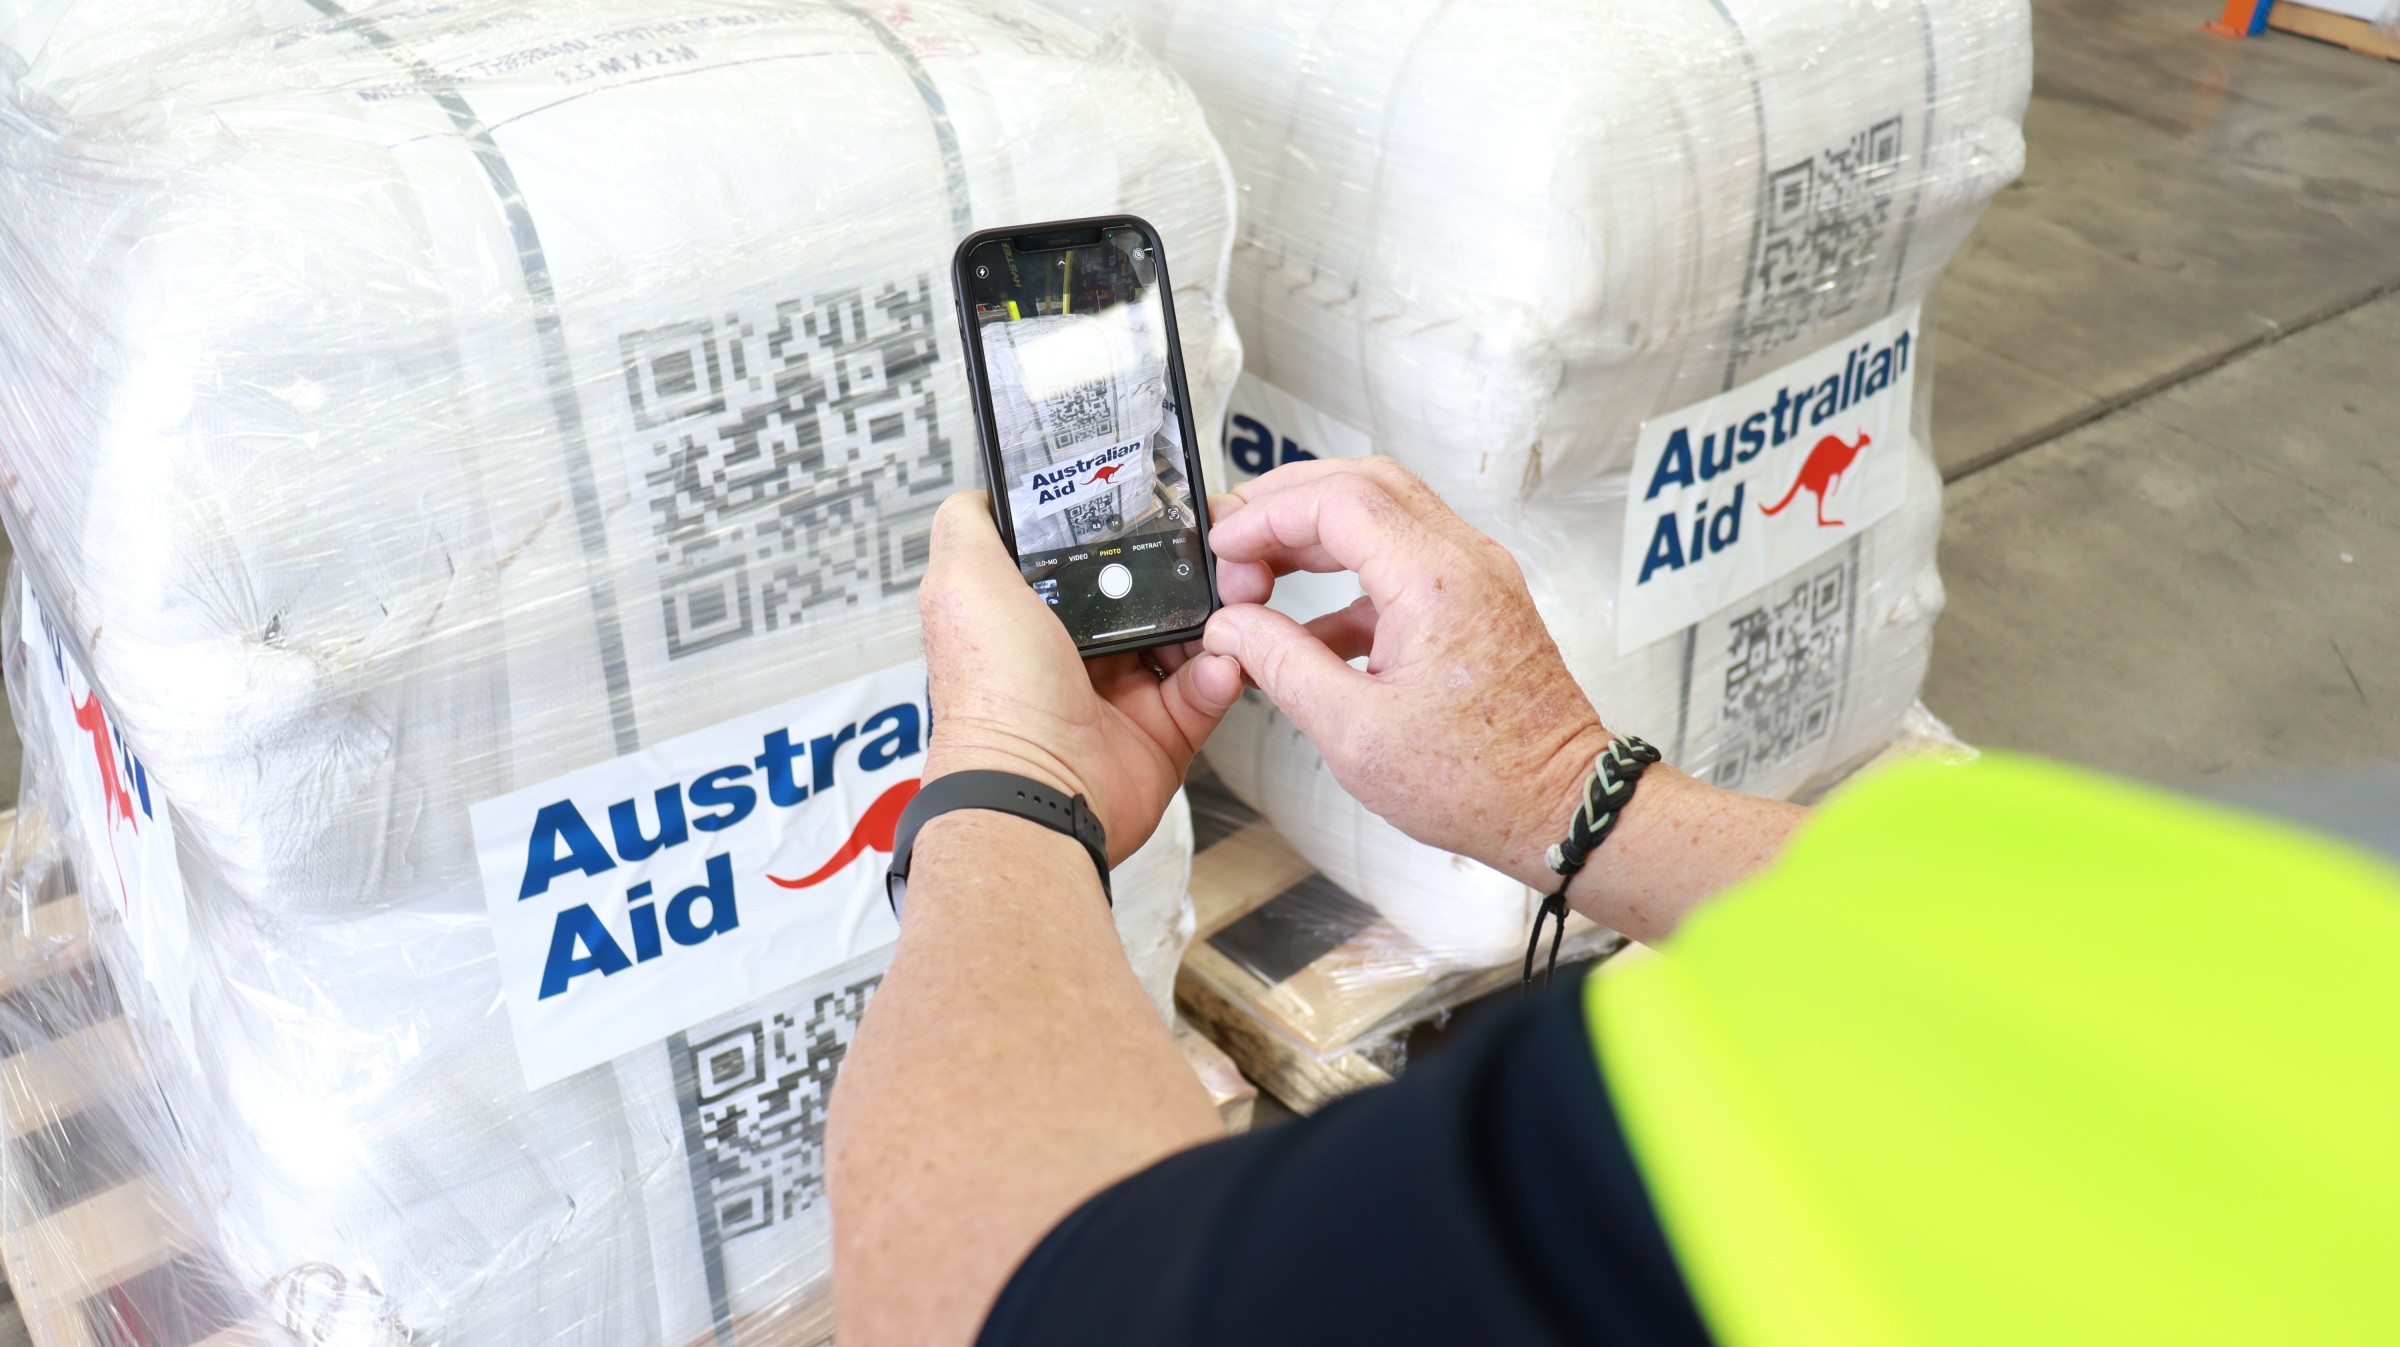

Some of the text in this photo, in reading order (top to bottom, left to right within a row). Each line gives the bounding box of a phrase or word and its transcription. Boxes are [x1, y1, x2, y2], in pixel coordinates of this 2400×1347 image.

[1032, 441, 1141, 491] Australian
[1644, 330, 1911, 502] Australian
[1038, 480, 1076, 506] Aid
[1637, 481, 1745, 586] Aid
[1035, 558, 1058, 568] SLO-MO
[1068, 553, 1089, 563] VIDEO
[1099, 547, 1122, 558] PHOTO
[1132, 540, 1163, 552] PORTRAIT
[518, 672, 932, 902] Austra
[538, 851, 740, 1001] Aid
